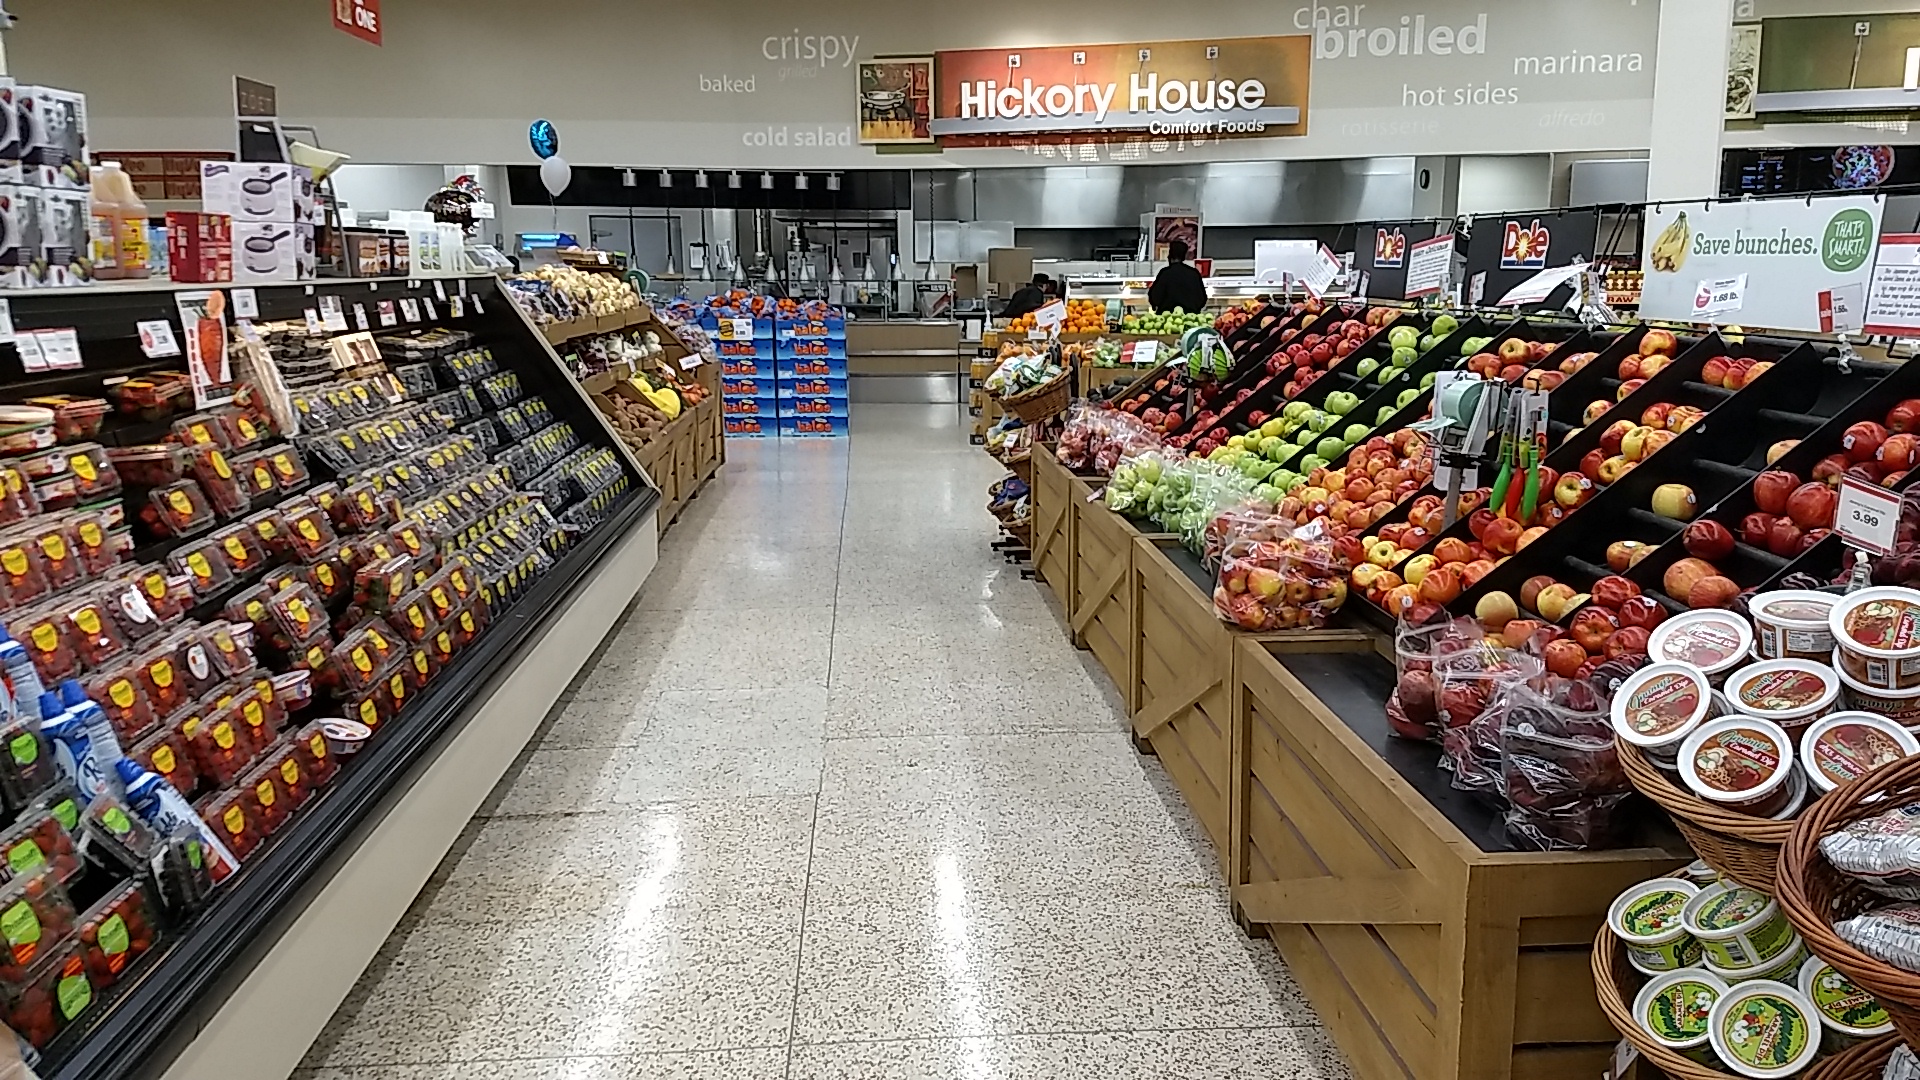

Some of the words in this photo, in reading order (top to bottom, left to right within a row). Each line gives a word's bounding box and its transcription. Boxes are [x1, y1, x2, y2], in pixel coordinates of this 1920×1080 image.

[355, 6, 378, 33] ONE
[1293, 0, 1366, 30] char
[762, 28, 859, 67] crispy
[1315, 13, 1488, 60] broiled
[1514, 50, 1643, 76] marinara
[700, 74, 756, 92] baked
[1402, 84, 1446, 107] hot
[1454, 82, 1519, 106] sides
[960, 77, 1117, 122] Hickory
[1128, 72, 1266, 113] House
[1149, 119, 1212, 135] Comfort
[1217, 117, 1266, 134] Foods
[1342, 117, 1441, 138] rotisserie
[1539, 108, 1606, 129] alfredo
[742, 126, 788, 147] cold
[794, 126, 850, 147] salad
[1376, 227, 1405, 259] Dole
[1503, 219, 1549, 258] Dole
[1693, 232, 1731, 255] Save
[1734, 228, 1818, 256] bunches.
[1827, 236, 1867, 259] SMART!
[1852, 510, 1879, 527] 3.99
[1729, 742, 1763, 760] Caramel
[1760, 755, 1776, 767] Dip
